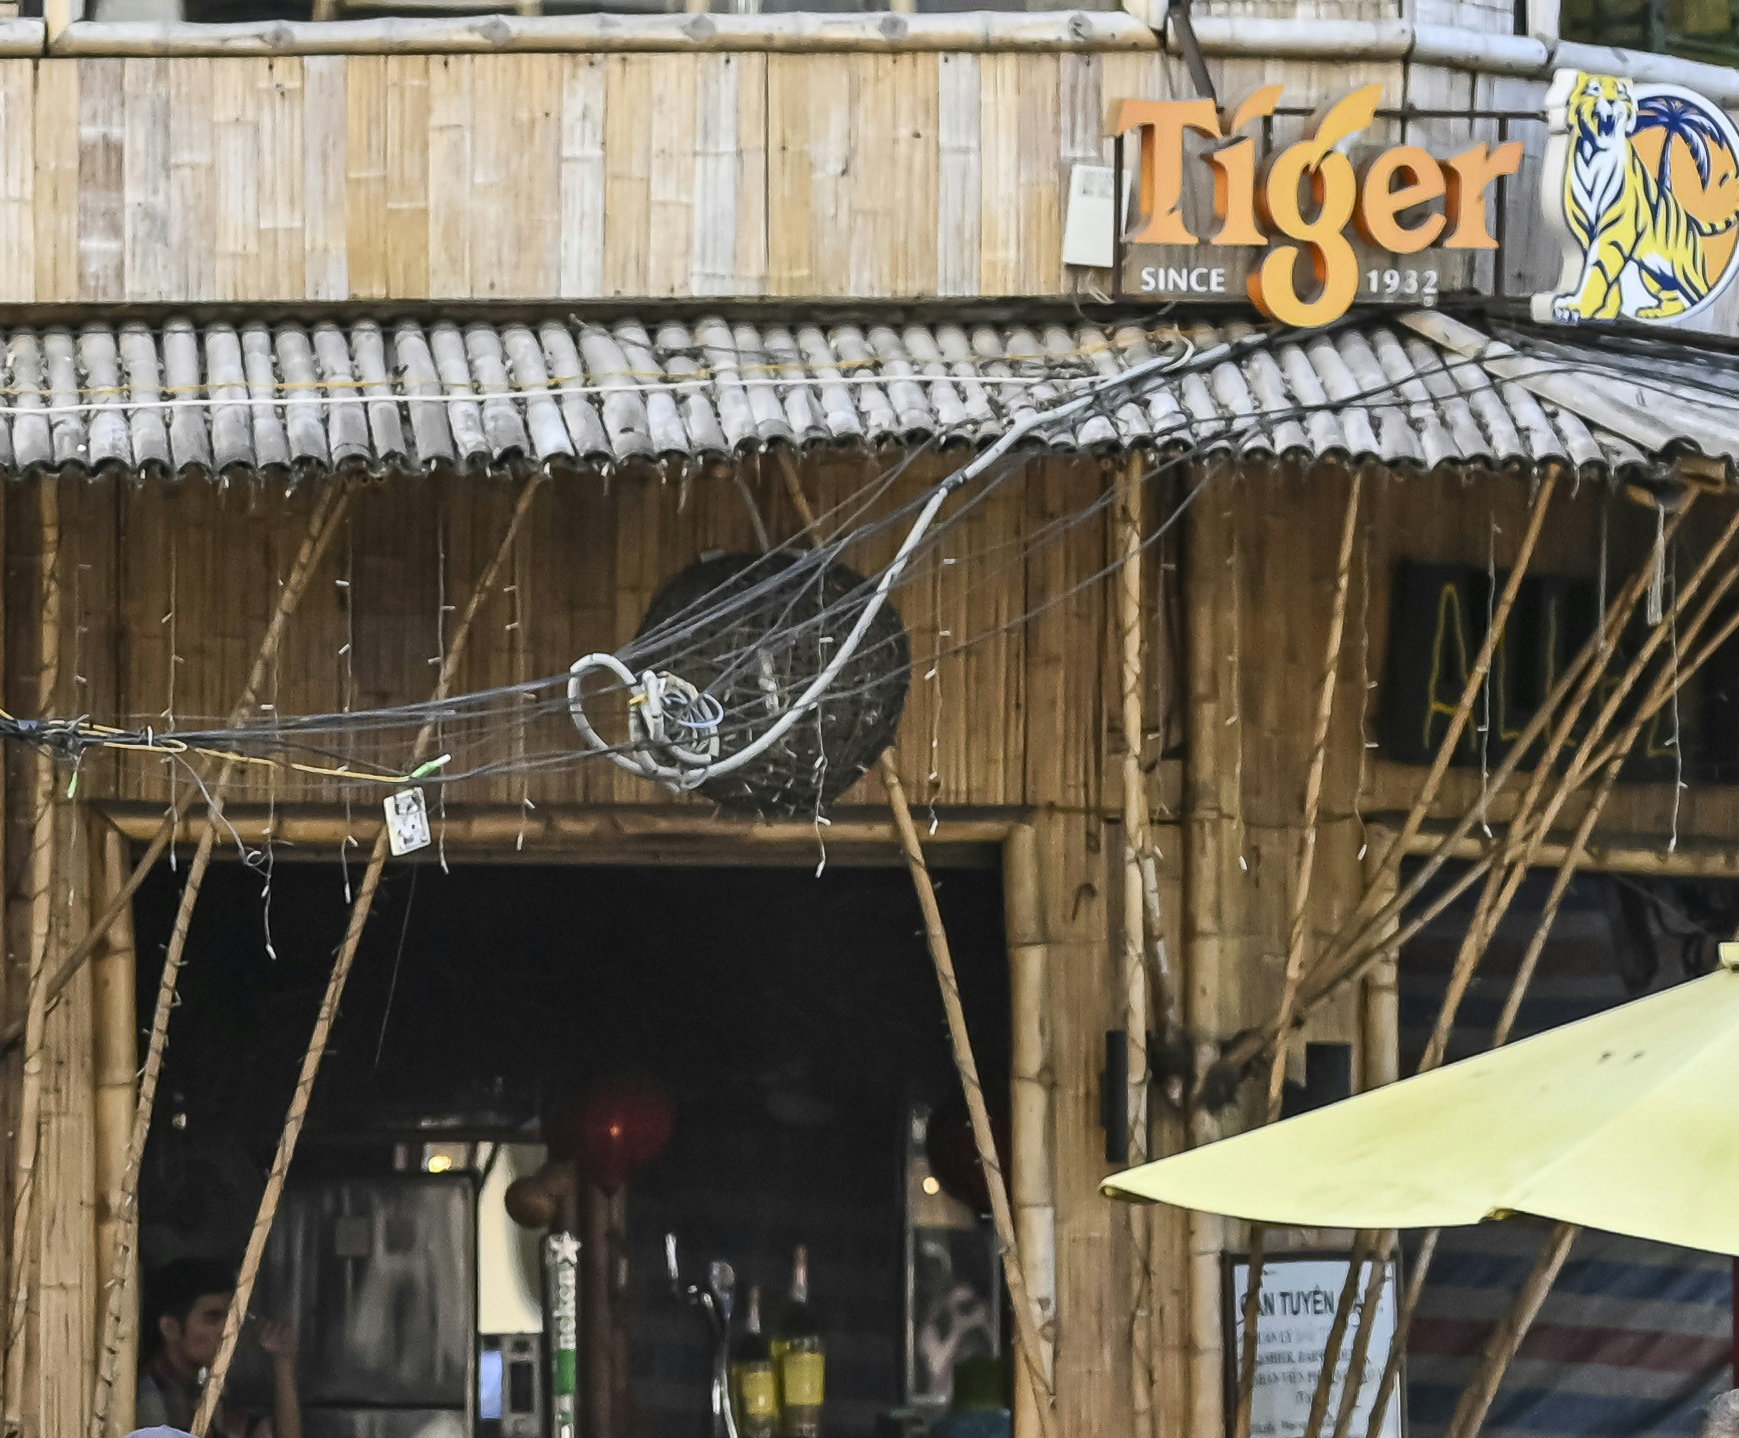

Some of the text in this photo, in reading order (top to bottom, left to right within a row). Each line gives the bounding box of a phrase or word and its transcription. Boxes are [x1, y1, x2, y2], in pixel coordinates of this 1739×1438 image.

[1114, 83, 1525, 328] Tiger
[1141, 267, 1439, 295] SINCE 1932
